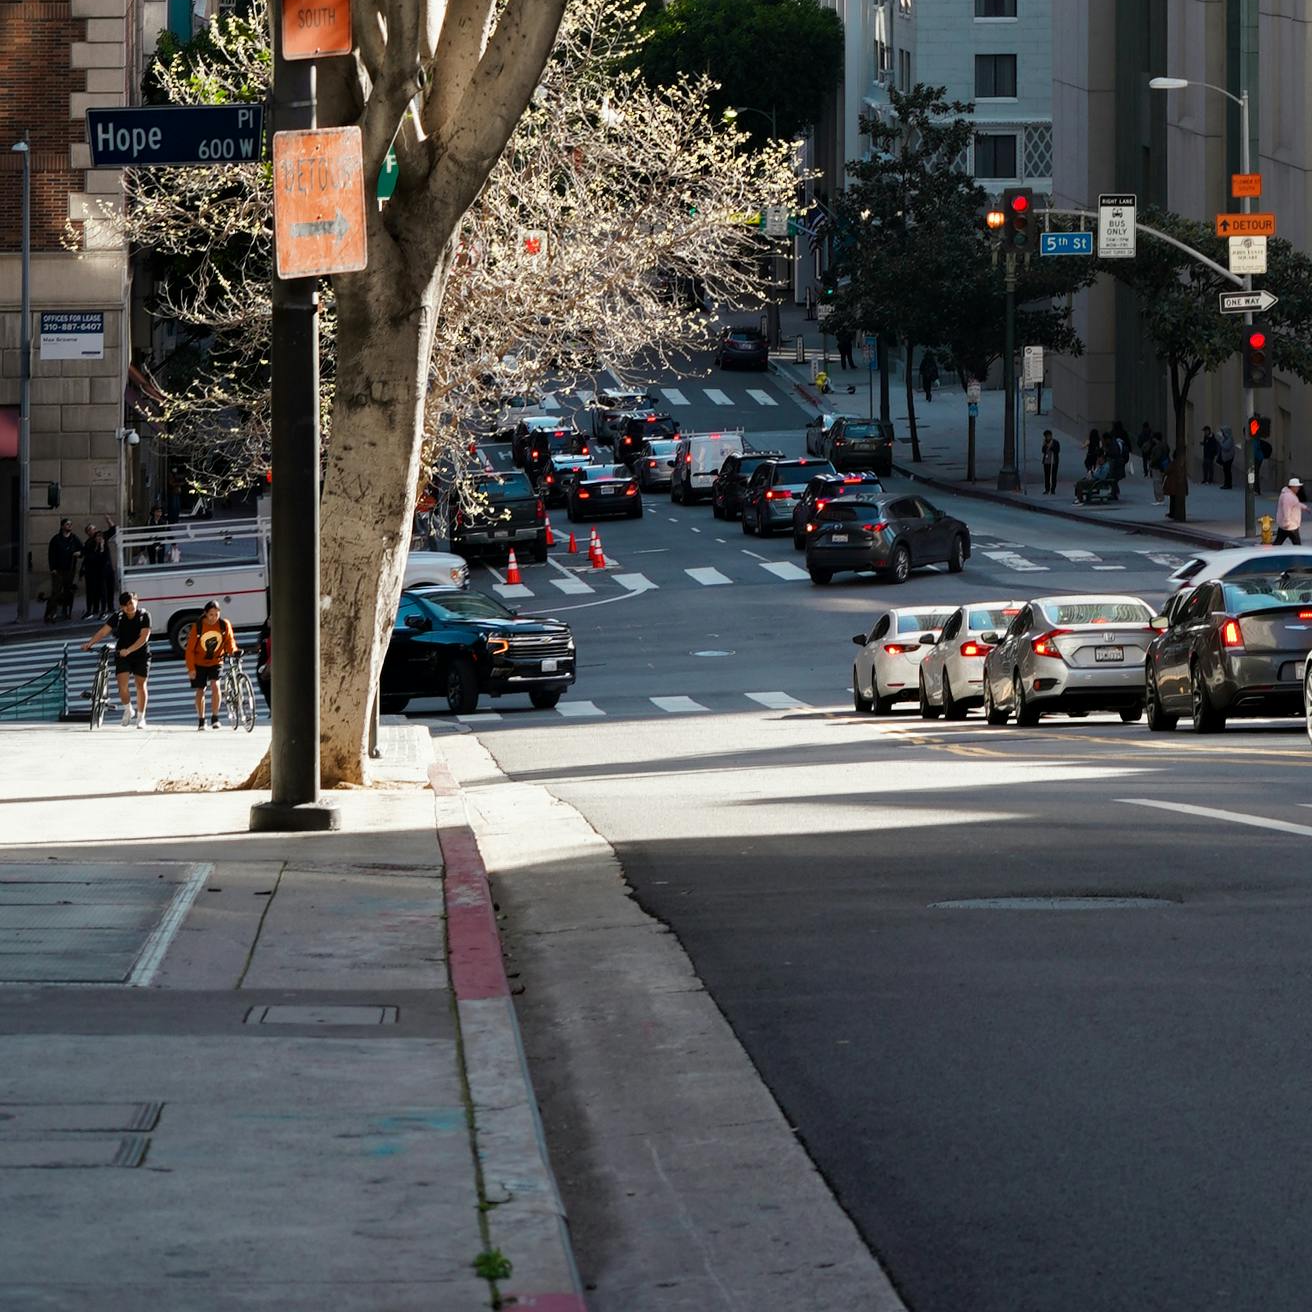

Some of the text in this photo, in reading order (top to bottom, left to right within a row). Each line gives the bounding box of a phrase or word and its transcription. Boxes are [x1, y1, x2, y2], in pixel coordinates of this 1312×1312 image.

[298, 8, 336, 29] SOUTH
[97, 109, 253, 157] Hope Pl
[198, 138, 254, 159] 600 W
[1106, 228, 1127, 236] ONLY
[1232, 220, 1272, 230] DETOUR
[1047, 237, 1087, 251] 5th St
[1226, 296, 1261, 307] ONE WAY
